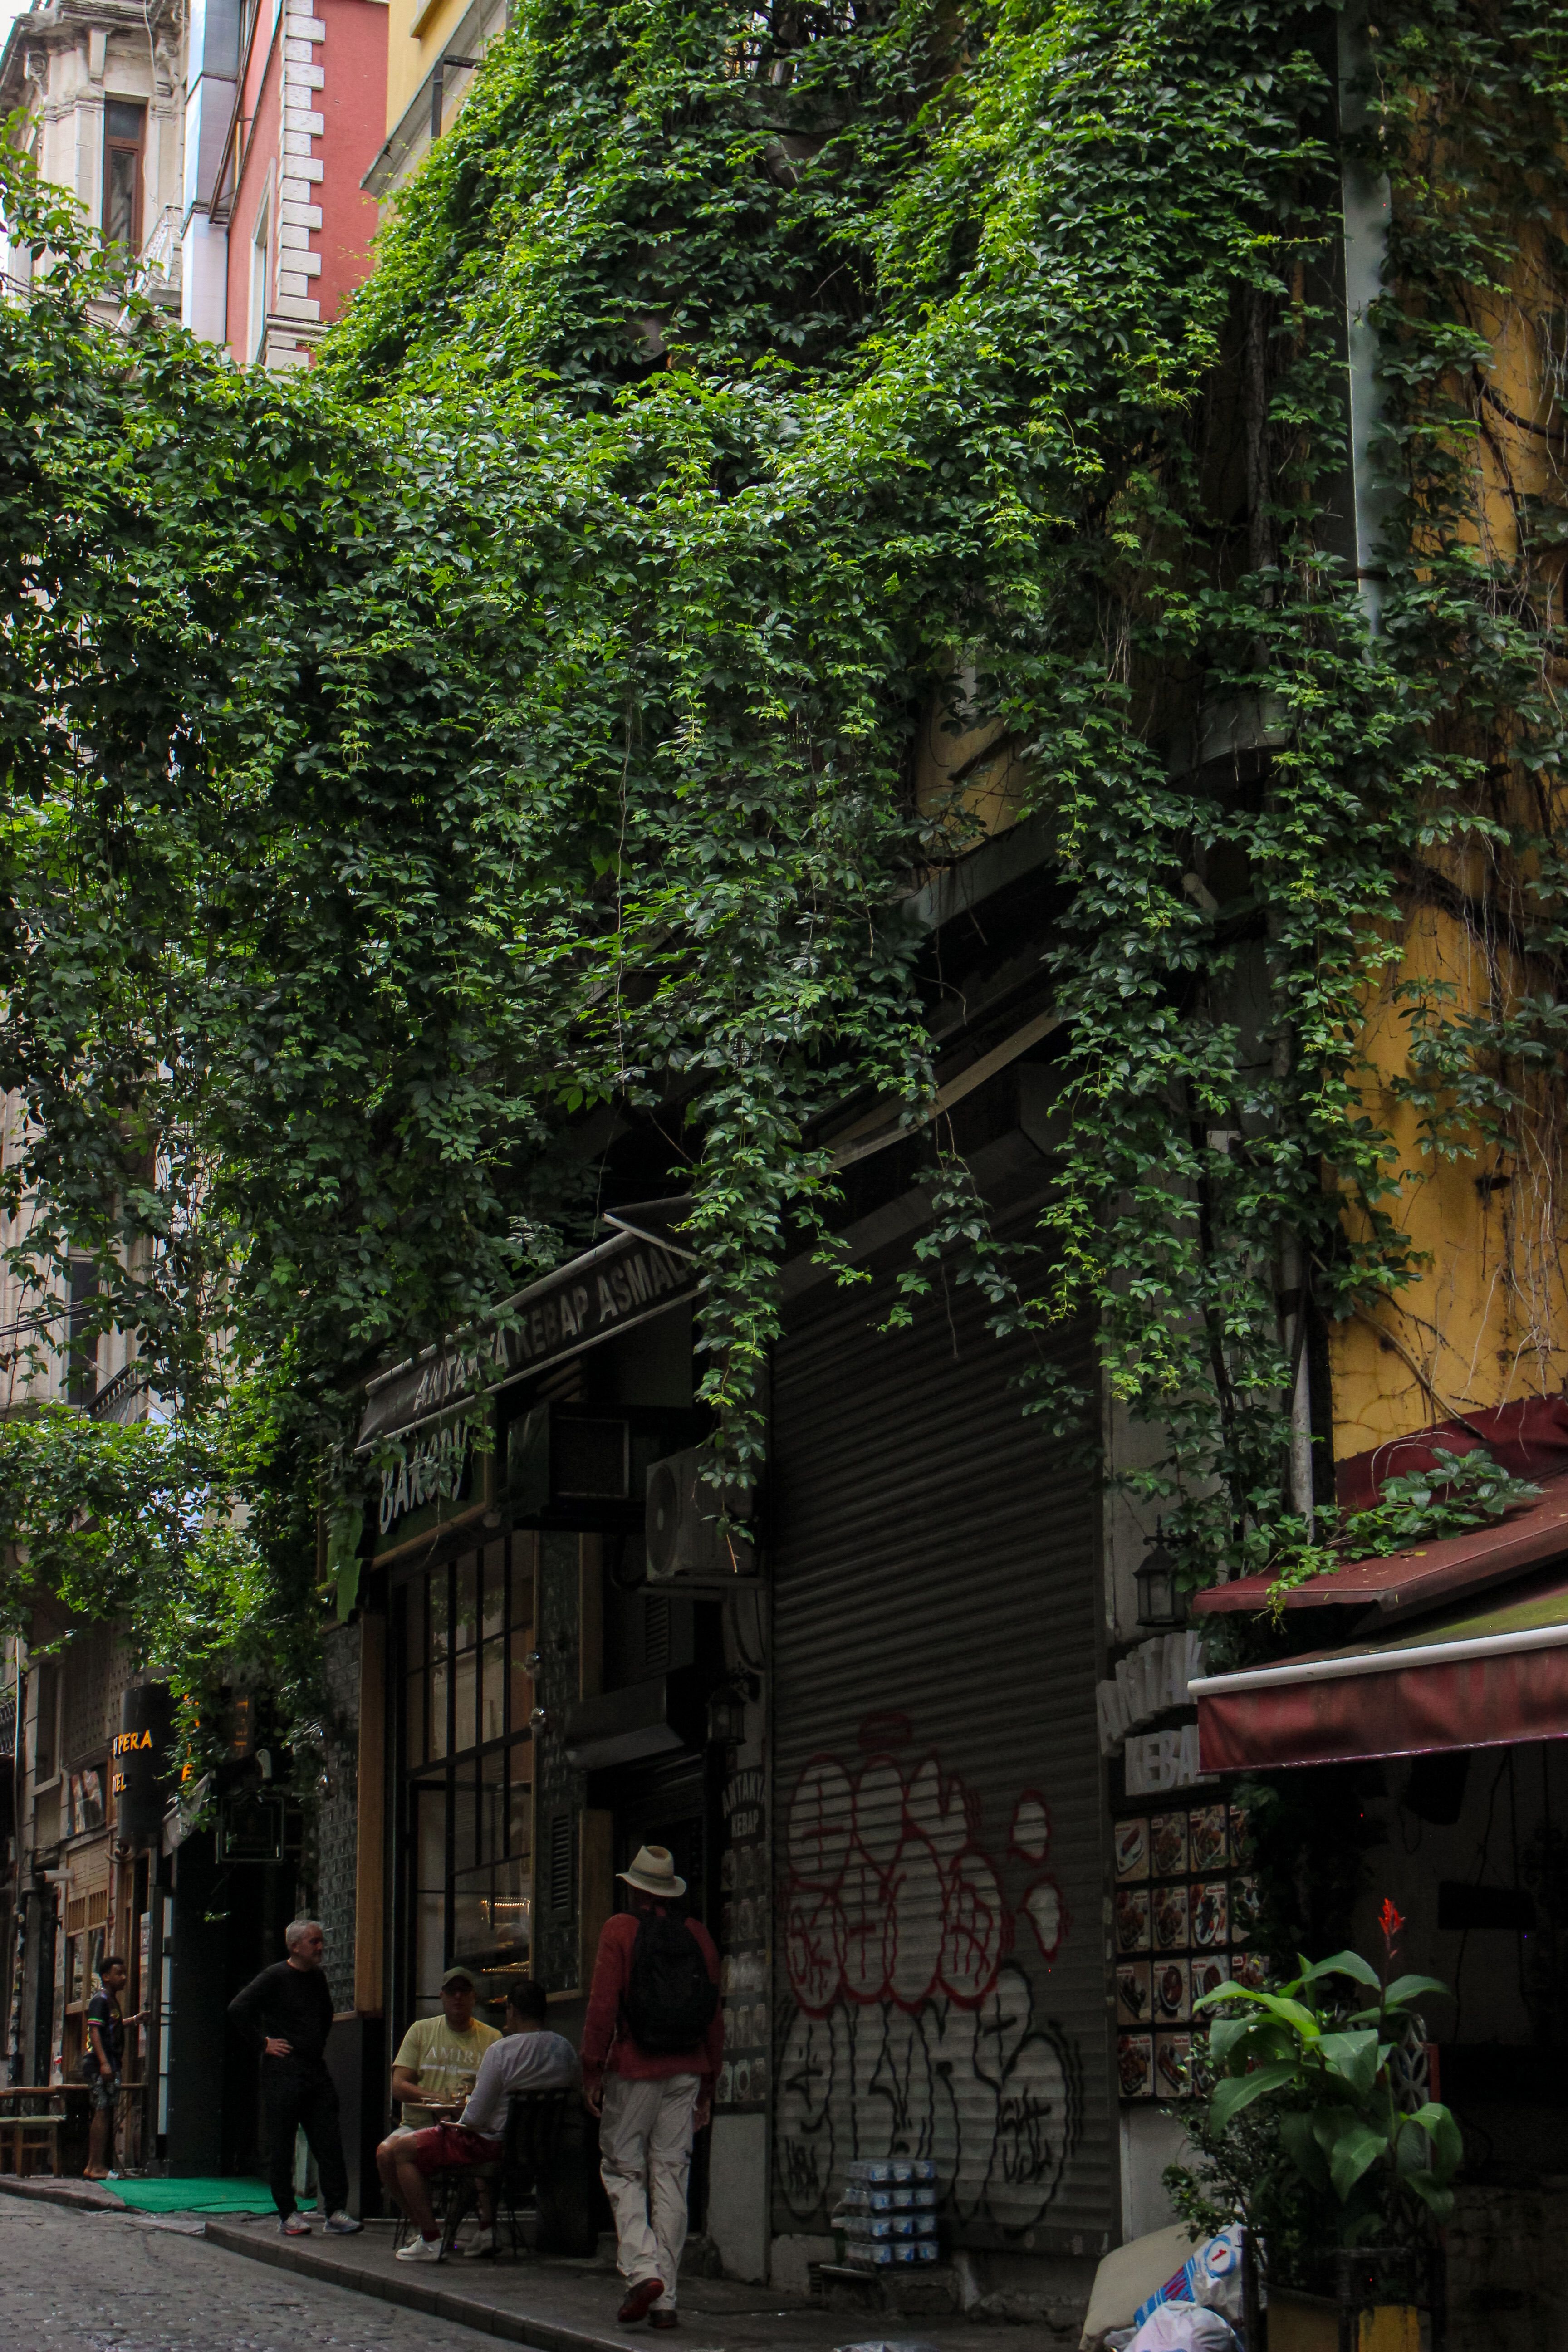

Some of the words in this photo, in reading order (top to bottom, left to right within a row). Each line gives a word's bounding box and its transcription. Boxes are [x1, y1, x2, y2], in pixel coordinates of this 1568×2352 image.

[514, 1286, 588, 1362] KEBAP
[596, 1247, 696, 1323] ASMAL
[1095, 1629, 1205, 1758] ANTAK
[1125, 1724, 1220, 1797] KEBA
[731, 1809, 759, 1838] KEBAP
[425, 2046, 482, 2064] AMIRI
